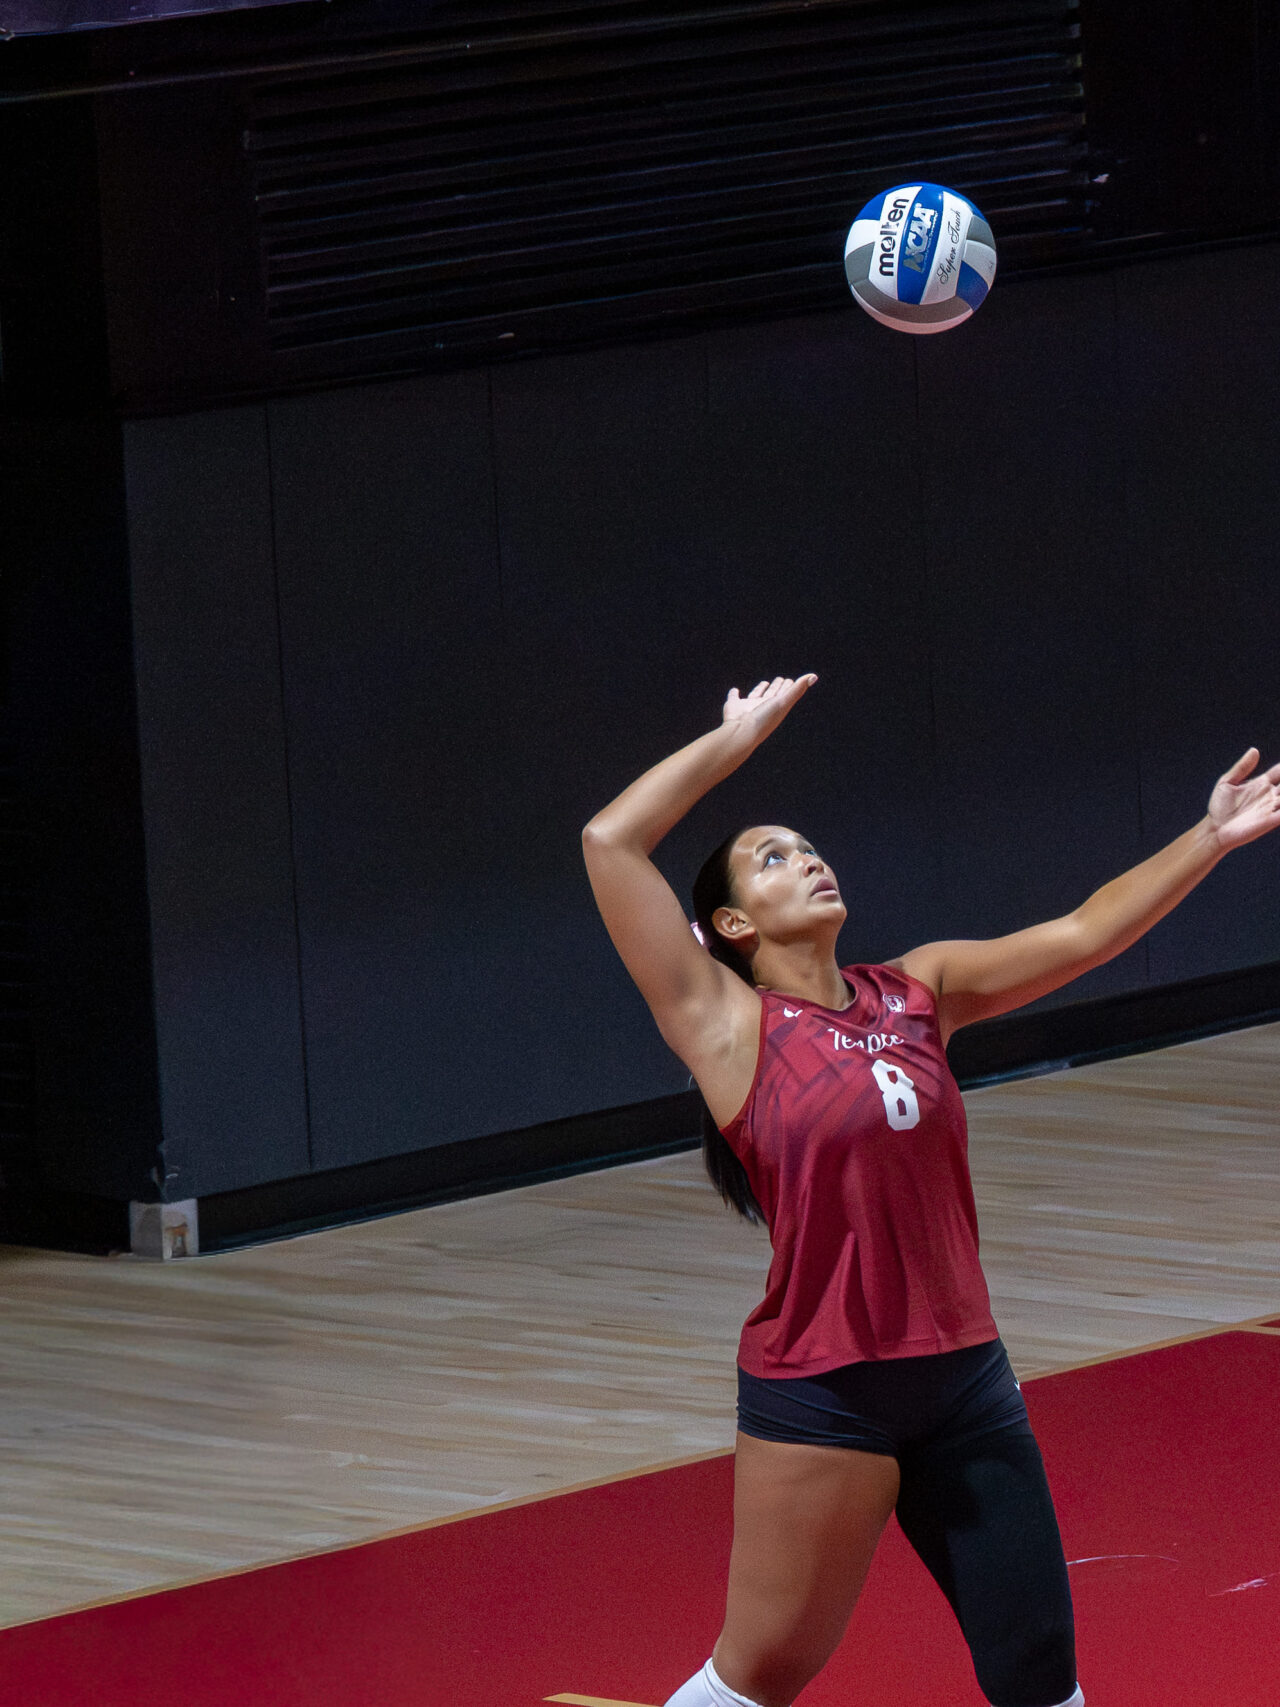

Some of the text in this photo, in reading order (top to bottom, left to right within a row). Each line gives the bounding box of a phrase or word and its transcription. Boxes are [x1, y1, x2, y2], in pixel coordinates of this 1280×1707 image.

[878, 198, 910, 277] molten
[904, 203, 936, 273] NCAA
[871, 1058, 921, 1132] 8
